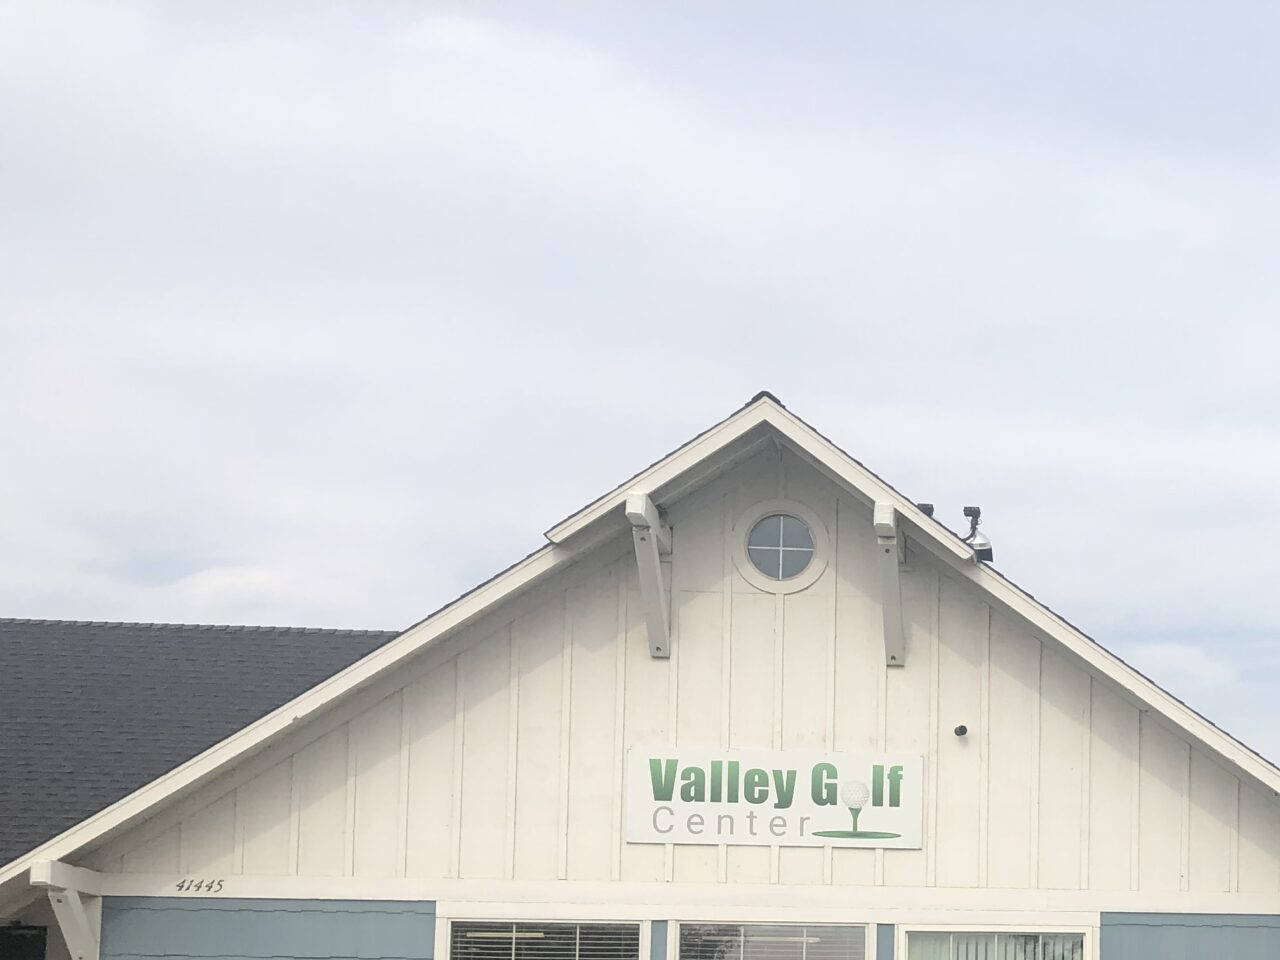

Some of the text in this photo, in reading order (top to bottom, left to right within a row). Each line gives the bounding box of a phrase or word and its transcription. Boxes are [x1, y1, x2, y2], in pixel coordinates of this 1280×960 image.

[649, 758, 797, 809] Valley
[652, 806, 811, 836] Center
[176, 879, 225, 893] 41445
